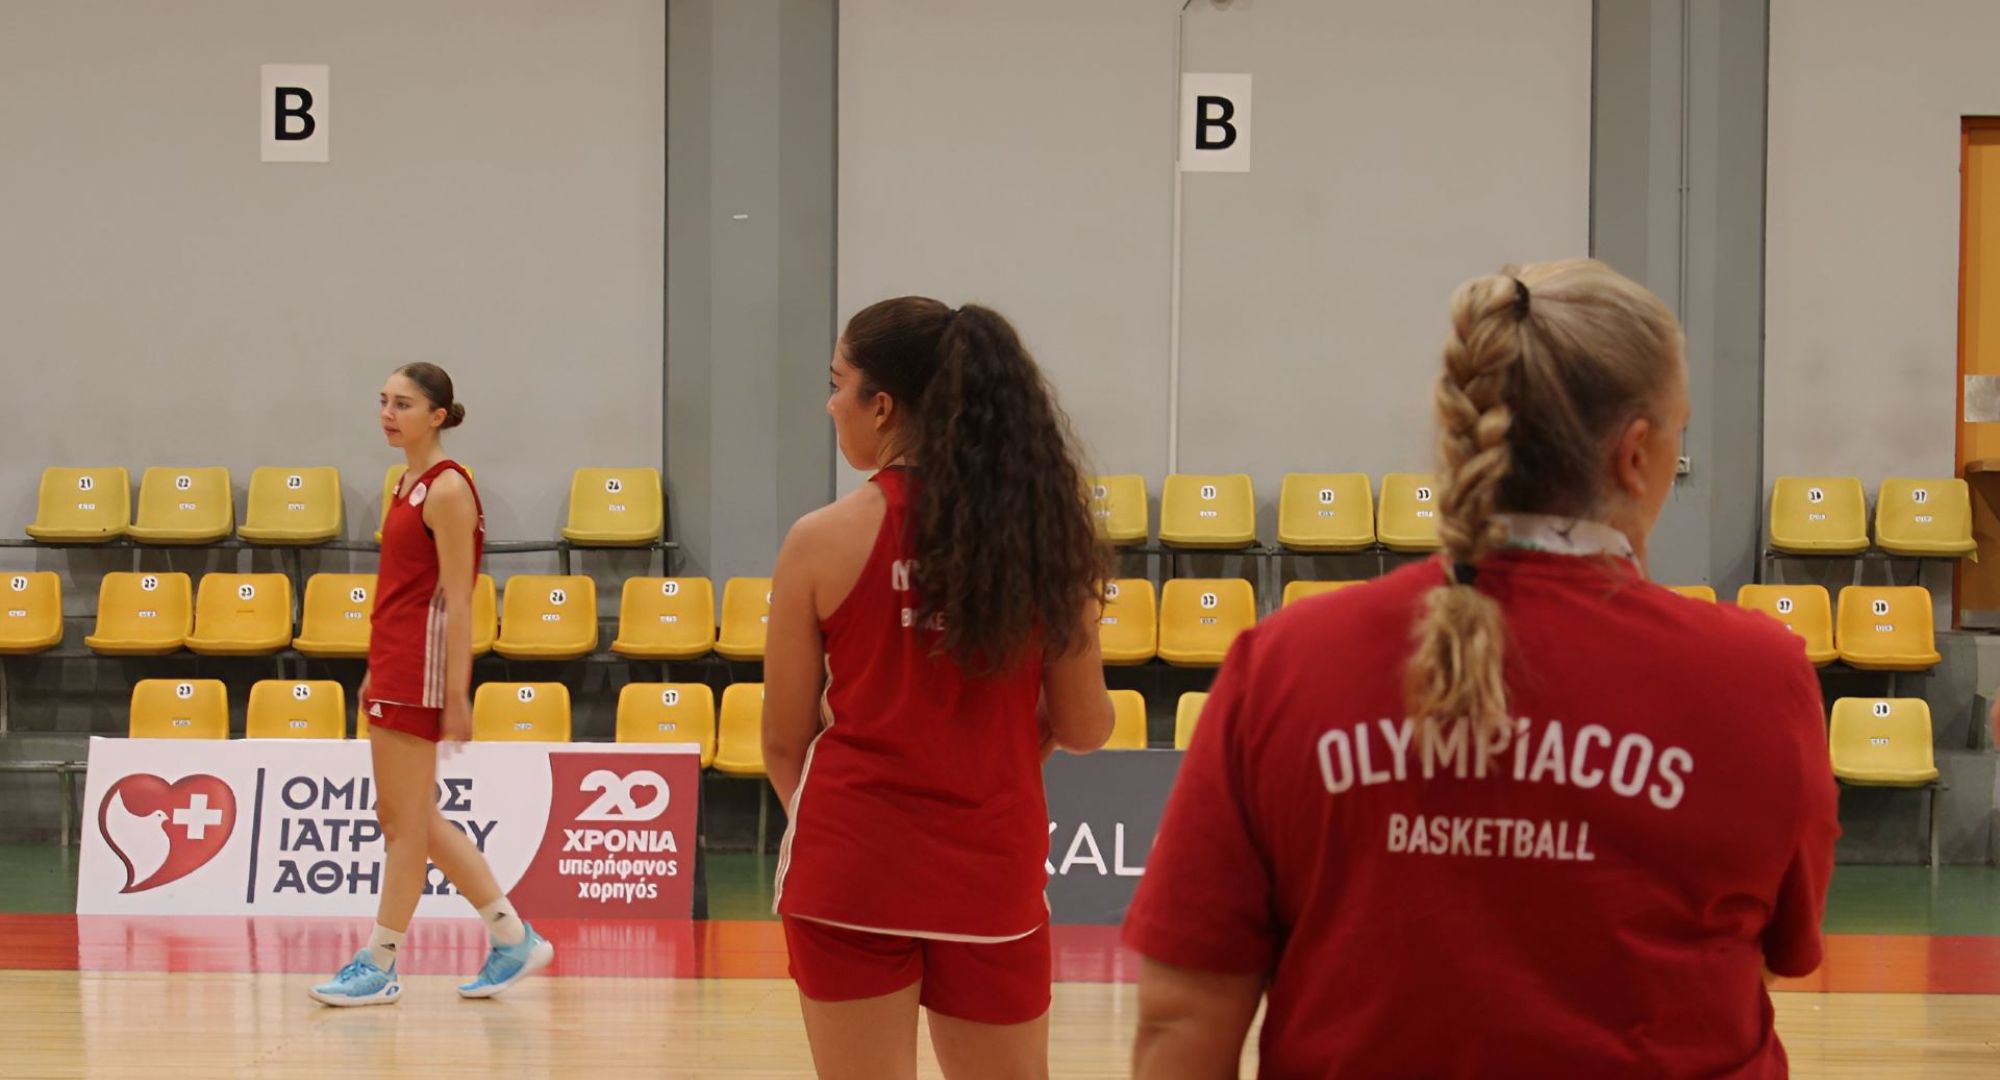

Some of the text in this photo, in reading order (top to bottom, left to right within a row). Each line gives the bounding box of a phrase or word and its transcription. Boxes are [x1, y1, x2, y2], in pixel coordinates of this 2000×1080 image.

[275, 86, 315, 140] B
[1195, 95, 1237, 150] B
[179, 686, 191, 696] 23
[1317, 716, 1693, 809] OLYMPIACOS
[281, 776, 473, 811] ΟΜΙΣ
[574, 769, 670, 821] 20
[280, 818, 498, 852] ΙΑΤΡΥ
[562, 828, 677, 853] ΧΡΟΝΙΑ
[1387, 813, 1595, 861] BASKETBALL
[273, 860, 463, 894] ΑΘΗΩ
[558, 854, 678, 880] υπερήφανος
[577, 877, 658, 904] χορηγός
